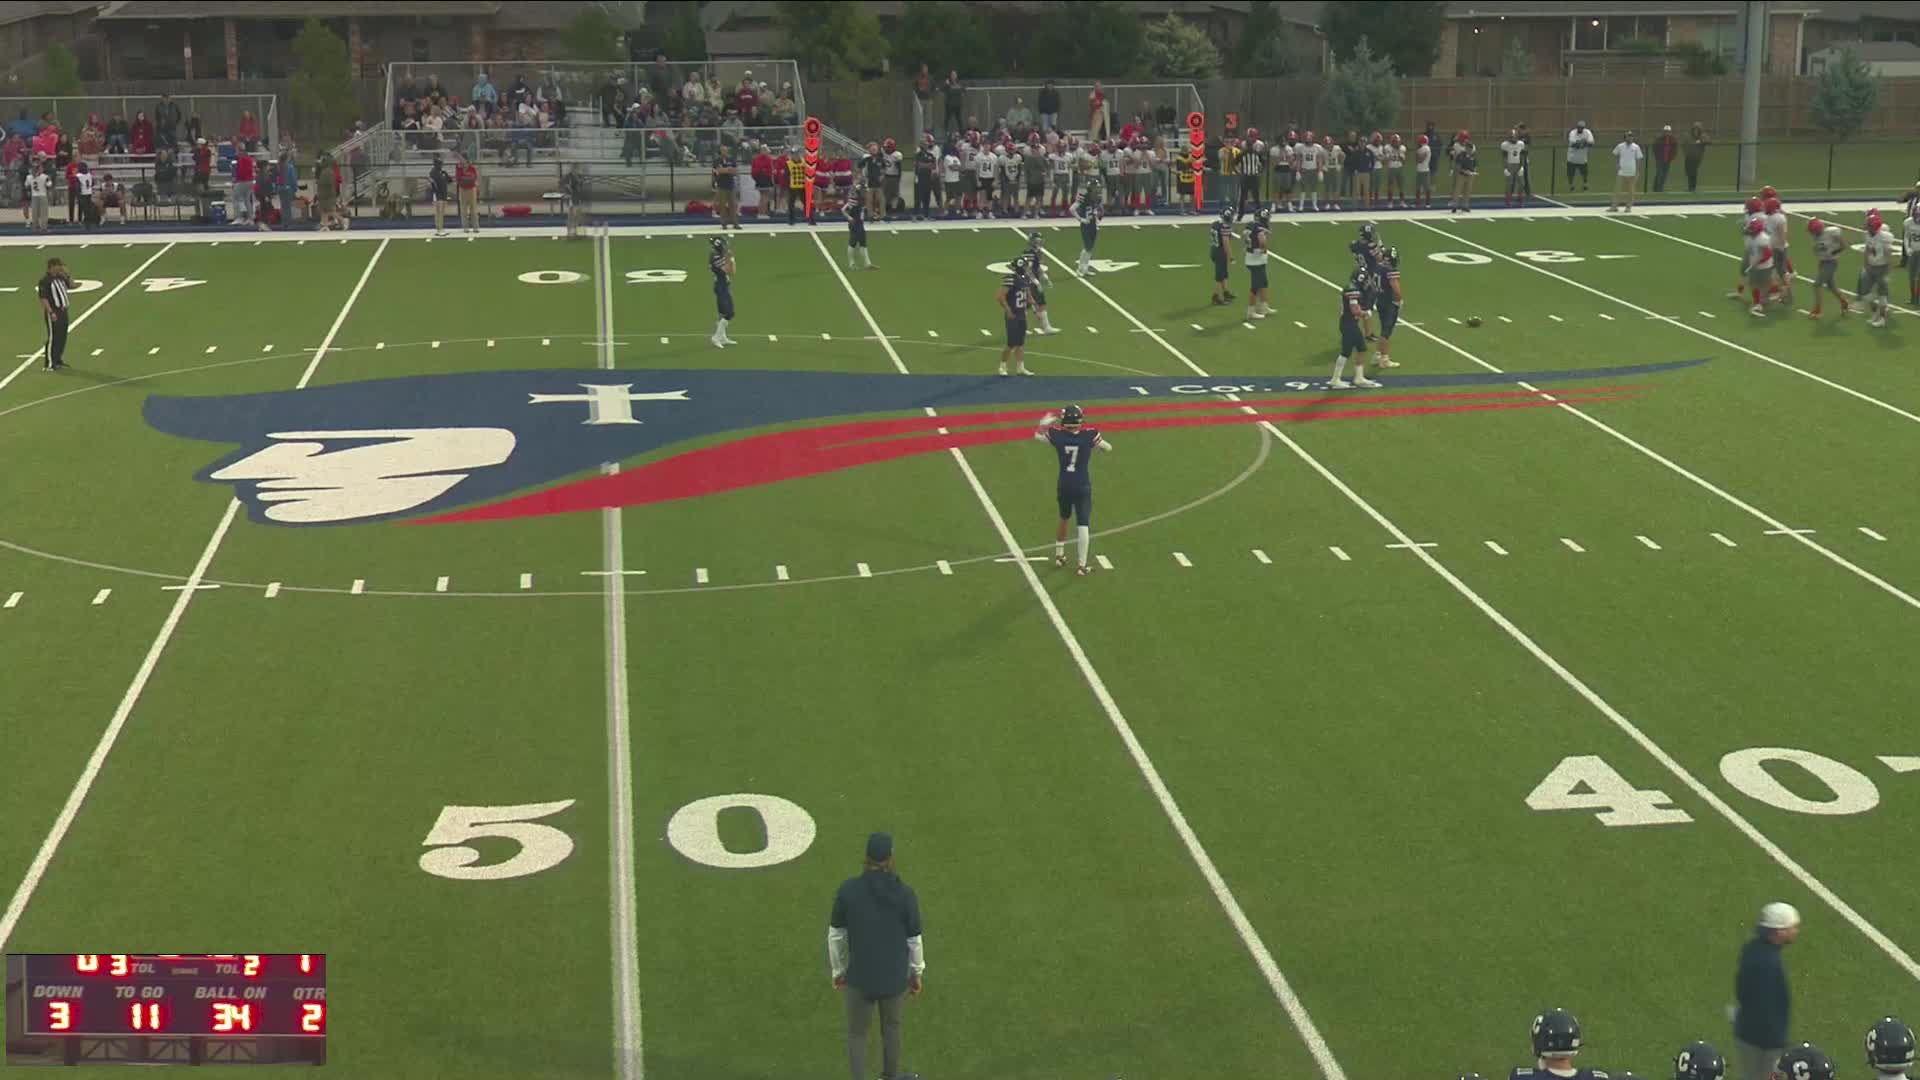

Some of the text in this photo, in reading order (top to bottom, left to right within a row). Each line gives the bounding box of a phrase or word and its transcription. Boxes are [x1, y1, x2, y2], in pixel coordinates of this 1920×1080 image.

[1224, 112, 1239, 129] 3
[1171, 384, 1272, 394] Cor.
[1064, 445, 1080, 472] 7
[110, 955, 127, 976] 3
[131, 963, 155, 975] TOL
[215, 964, 239, 975] TOL
[244, 955, 260, 976] 2
[33, 985, 84, 998] DOWN
[115, 986, 164, 998] TO GO
[195, 986, 267, 999] BALL ON
[293, 987, 325, 999] QTR
[49, 1002, 70, 1030] 3
[131, 1003, 160, 1030] 11
[212, 1003, 250, 1030] 34
[302, 1003, 323, 1031] 2
[1532, 1014, 1544, 1035] C
[1867, 1029, 1877, 1051] C
[1678, 1051, 1691, 1073] C
[1793, 1060, 1808, 1080] C
